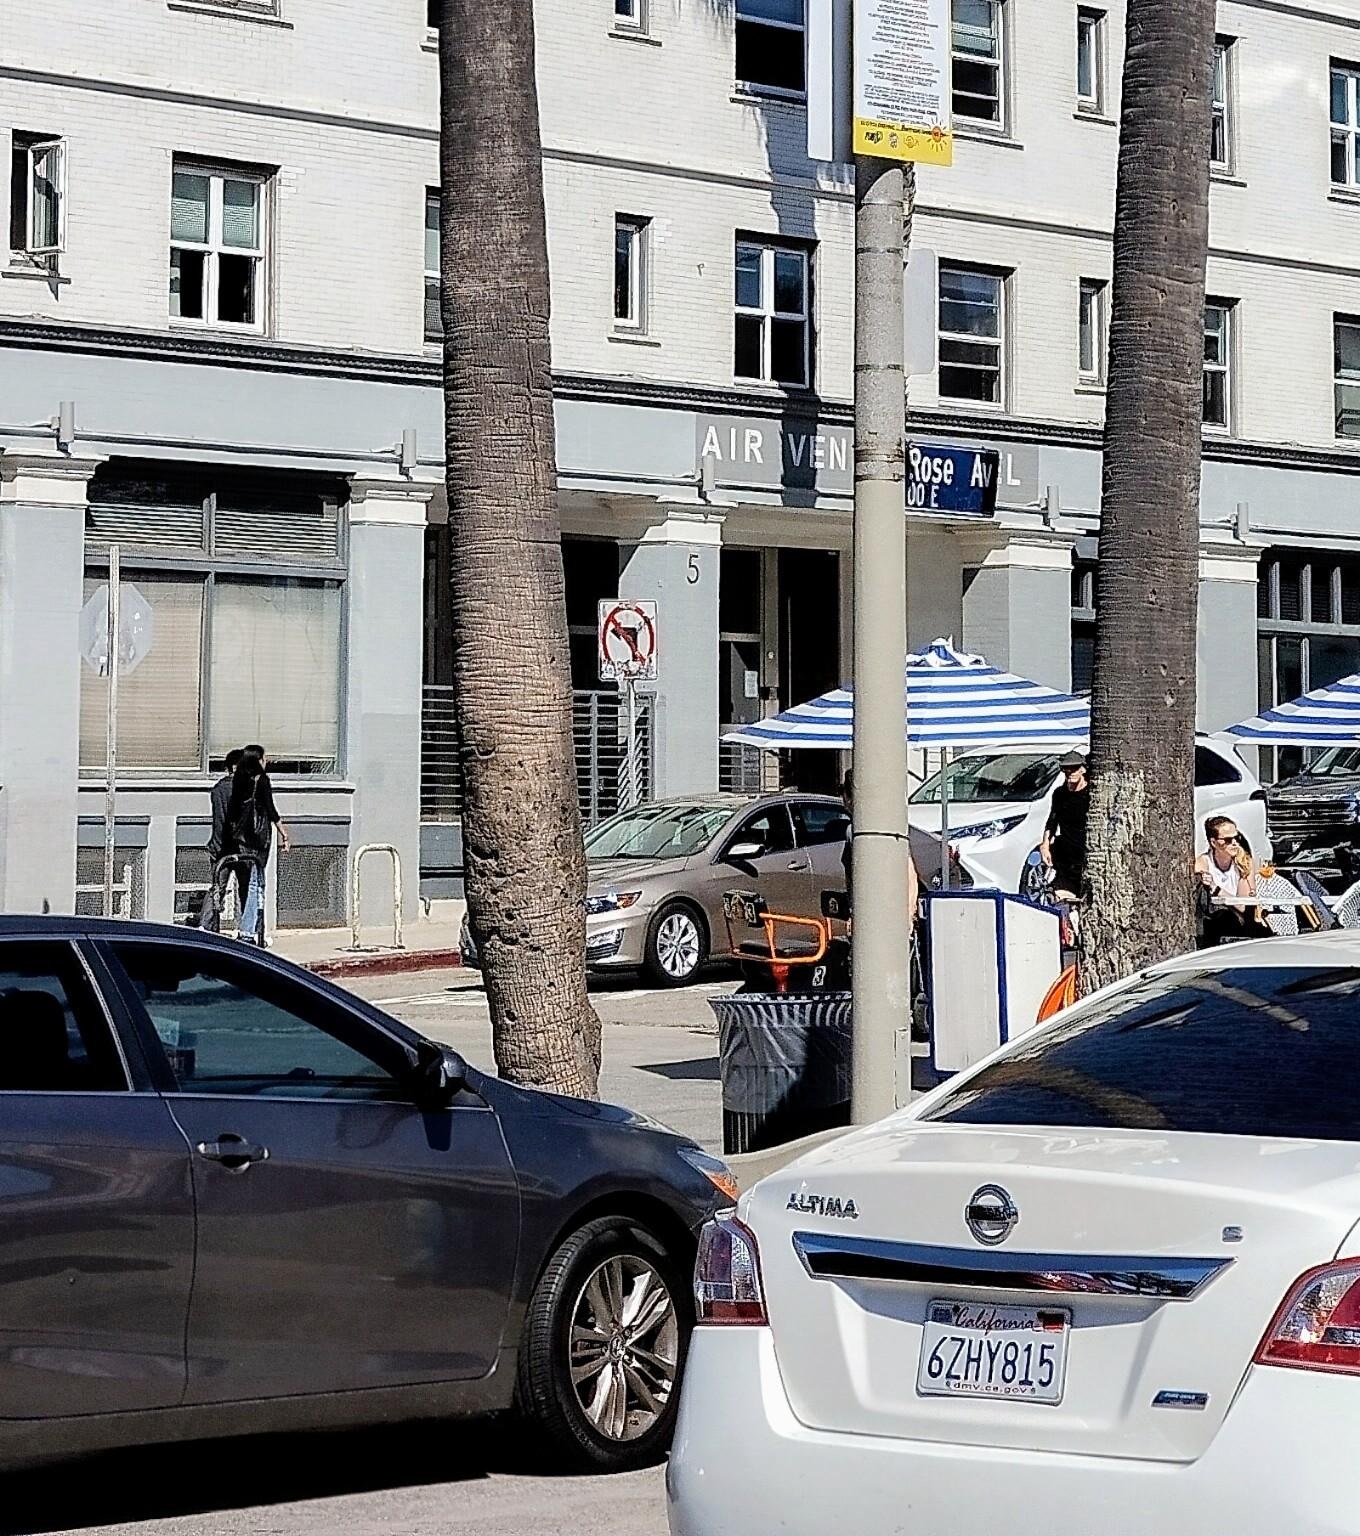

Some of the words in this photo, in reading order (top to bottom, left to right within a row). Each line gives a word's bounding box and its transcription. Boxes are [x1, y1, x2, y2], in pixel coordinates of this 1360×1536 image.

[702, 425, 764, 464] AIR
[788, 434, 847, 471] VEN
[909, 447, 954, 486] Rose
[970, 453, 993, 488] Av
[930, 484, 940, 508] E
[686, 553, 700, 585] 5
[786, 1192, 860, 1220] ALTIMA
[955, 1305, 1036, 1336] California
[927, 1336, 1056, 1388] 6ZHY815
[953, 1382, 1027, 1395] dmv.ca.gov
